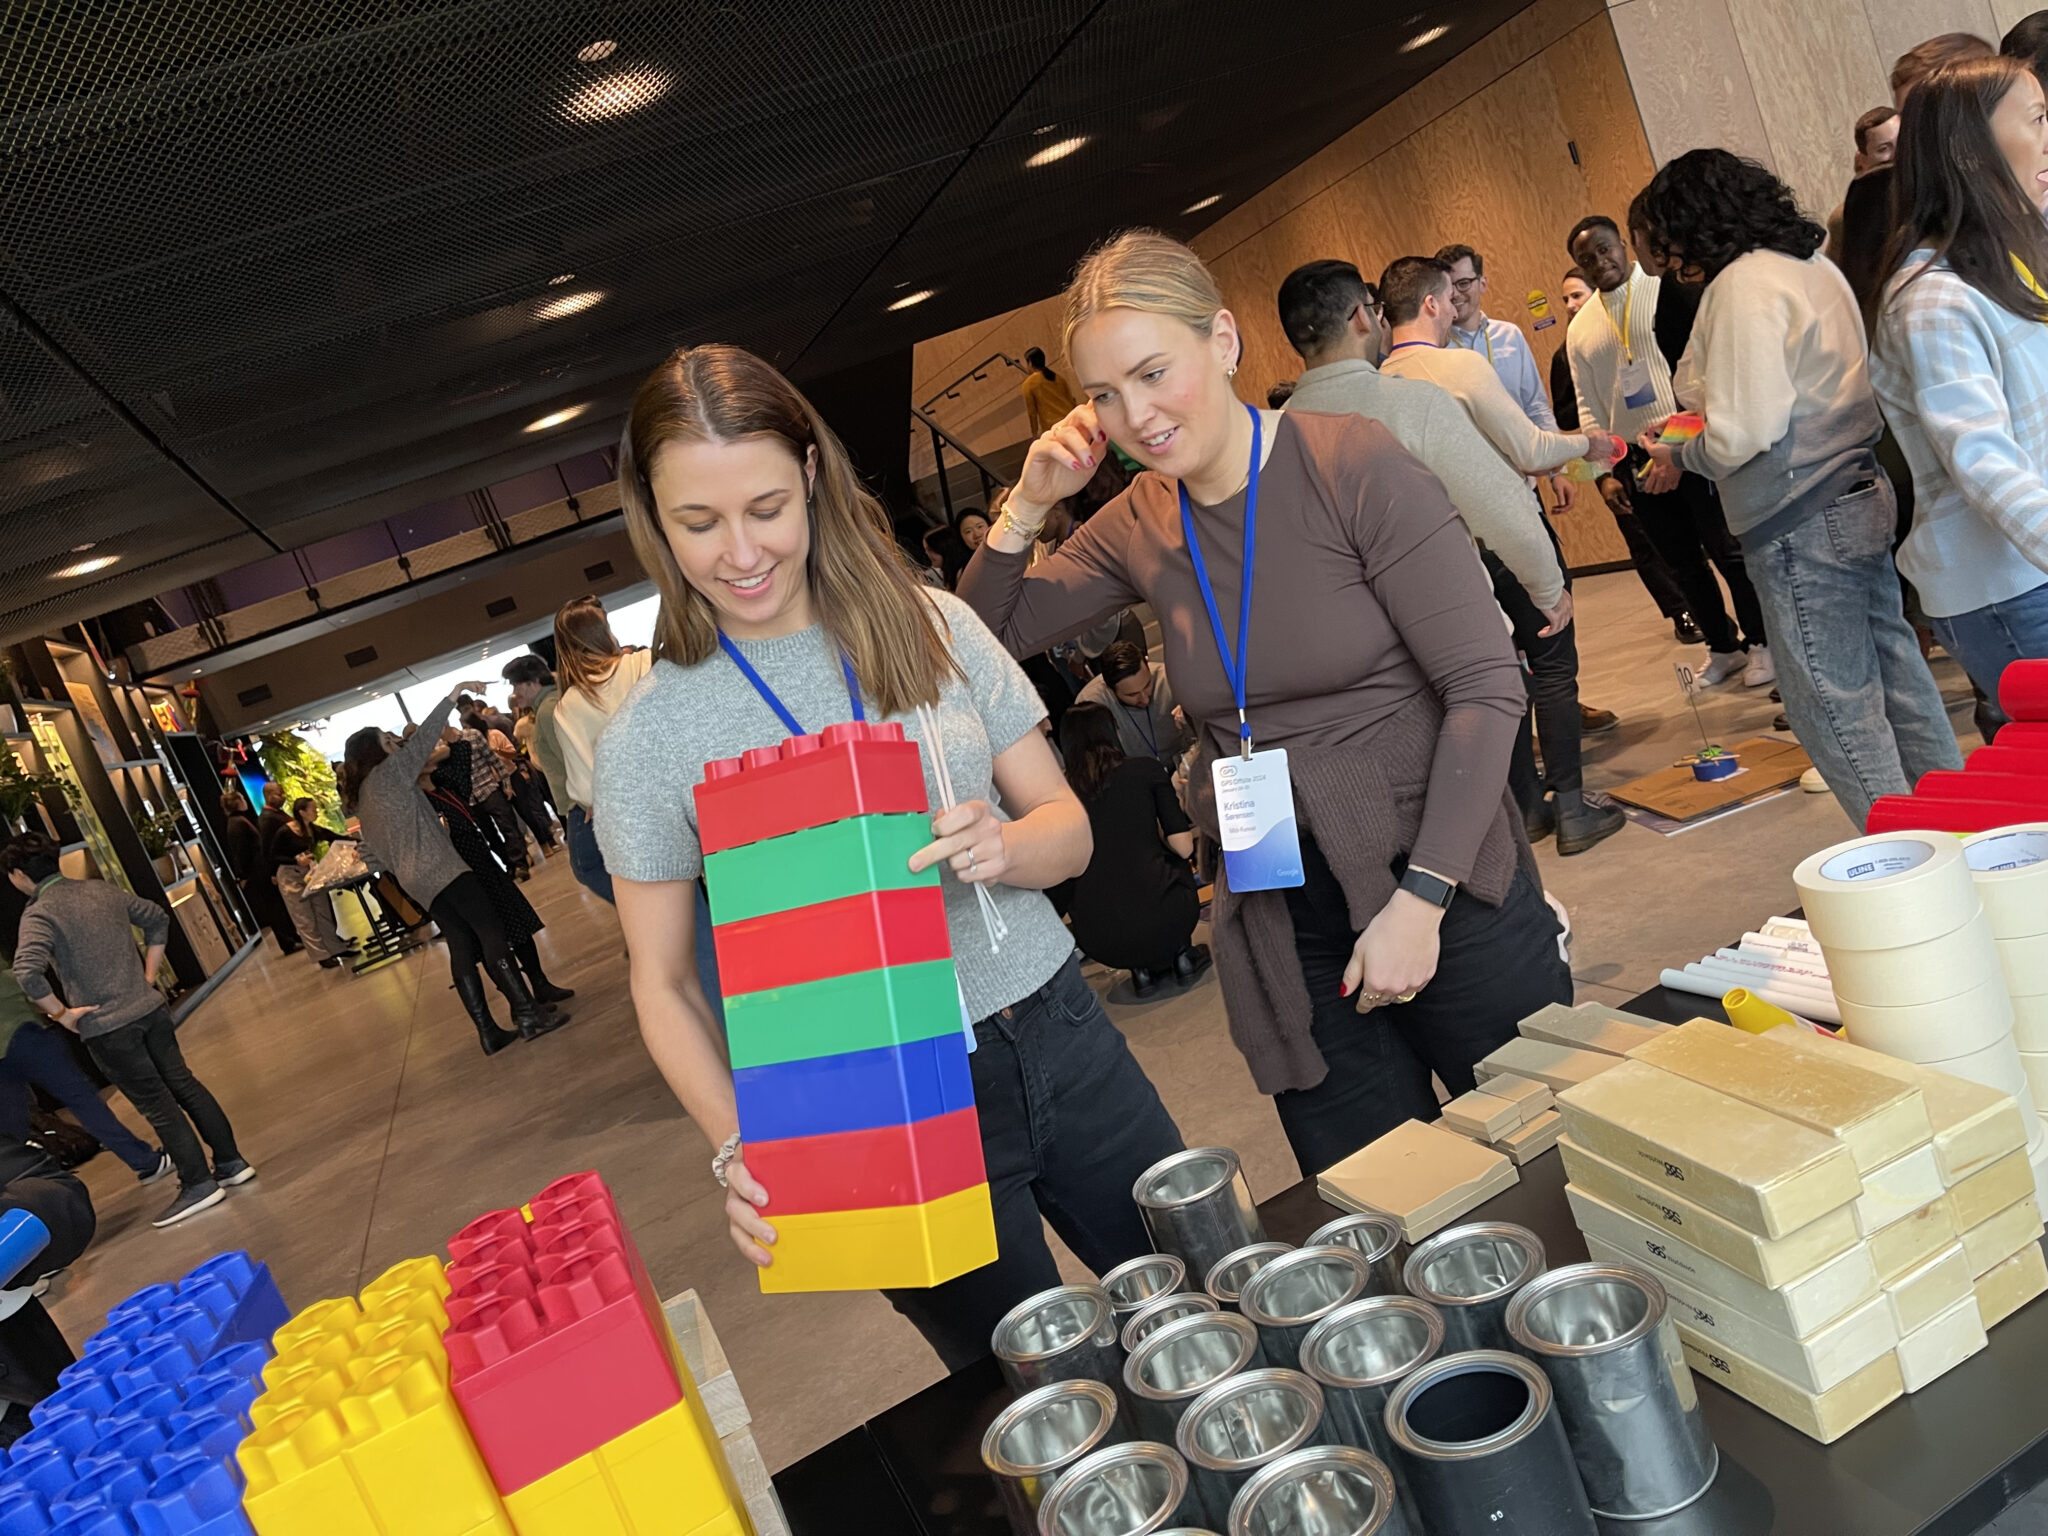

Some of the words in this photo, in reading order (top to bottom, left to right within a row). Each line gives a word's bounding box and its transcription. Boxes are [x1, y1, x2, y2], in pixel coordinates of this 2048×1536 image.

[1678, 667, 1693, 685] 10
[1223, 800, 1255, 811] Kristina
[1847, 863, 1874, 878] ULINE
